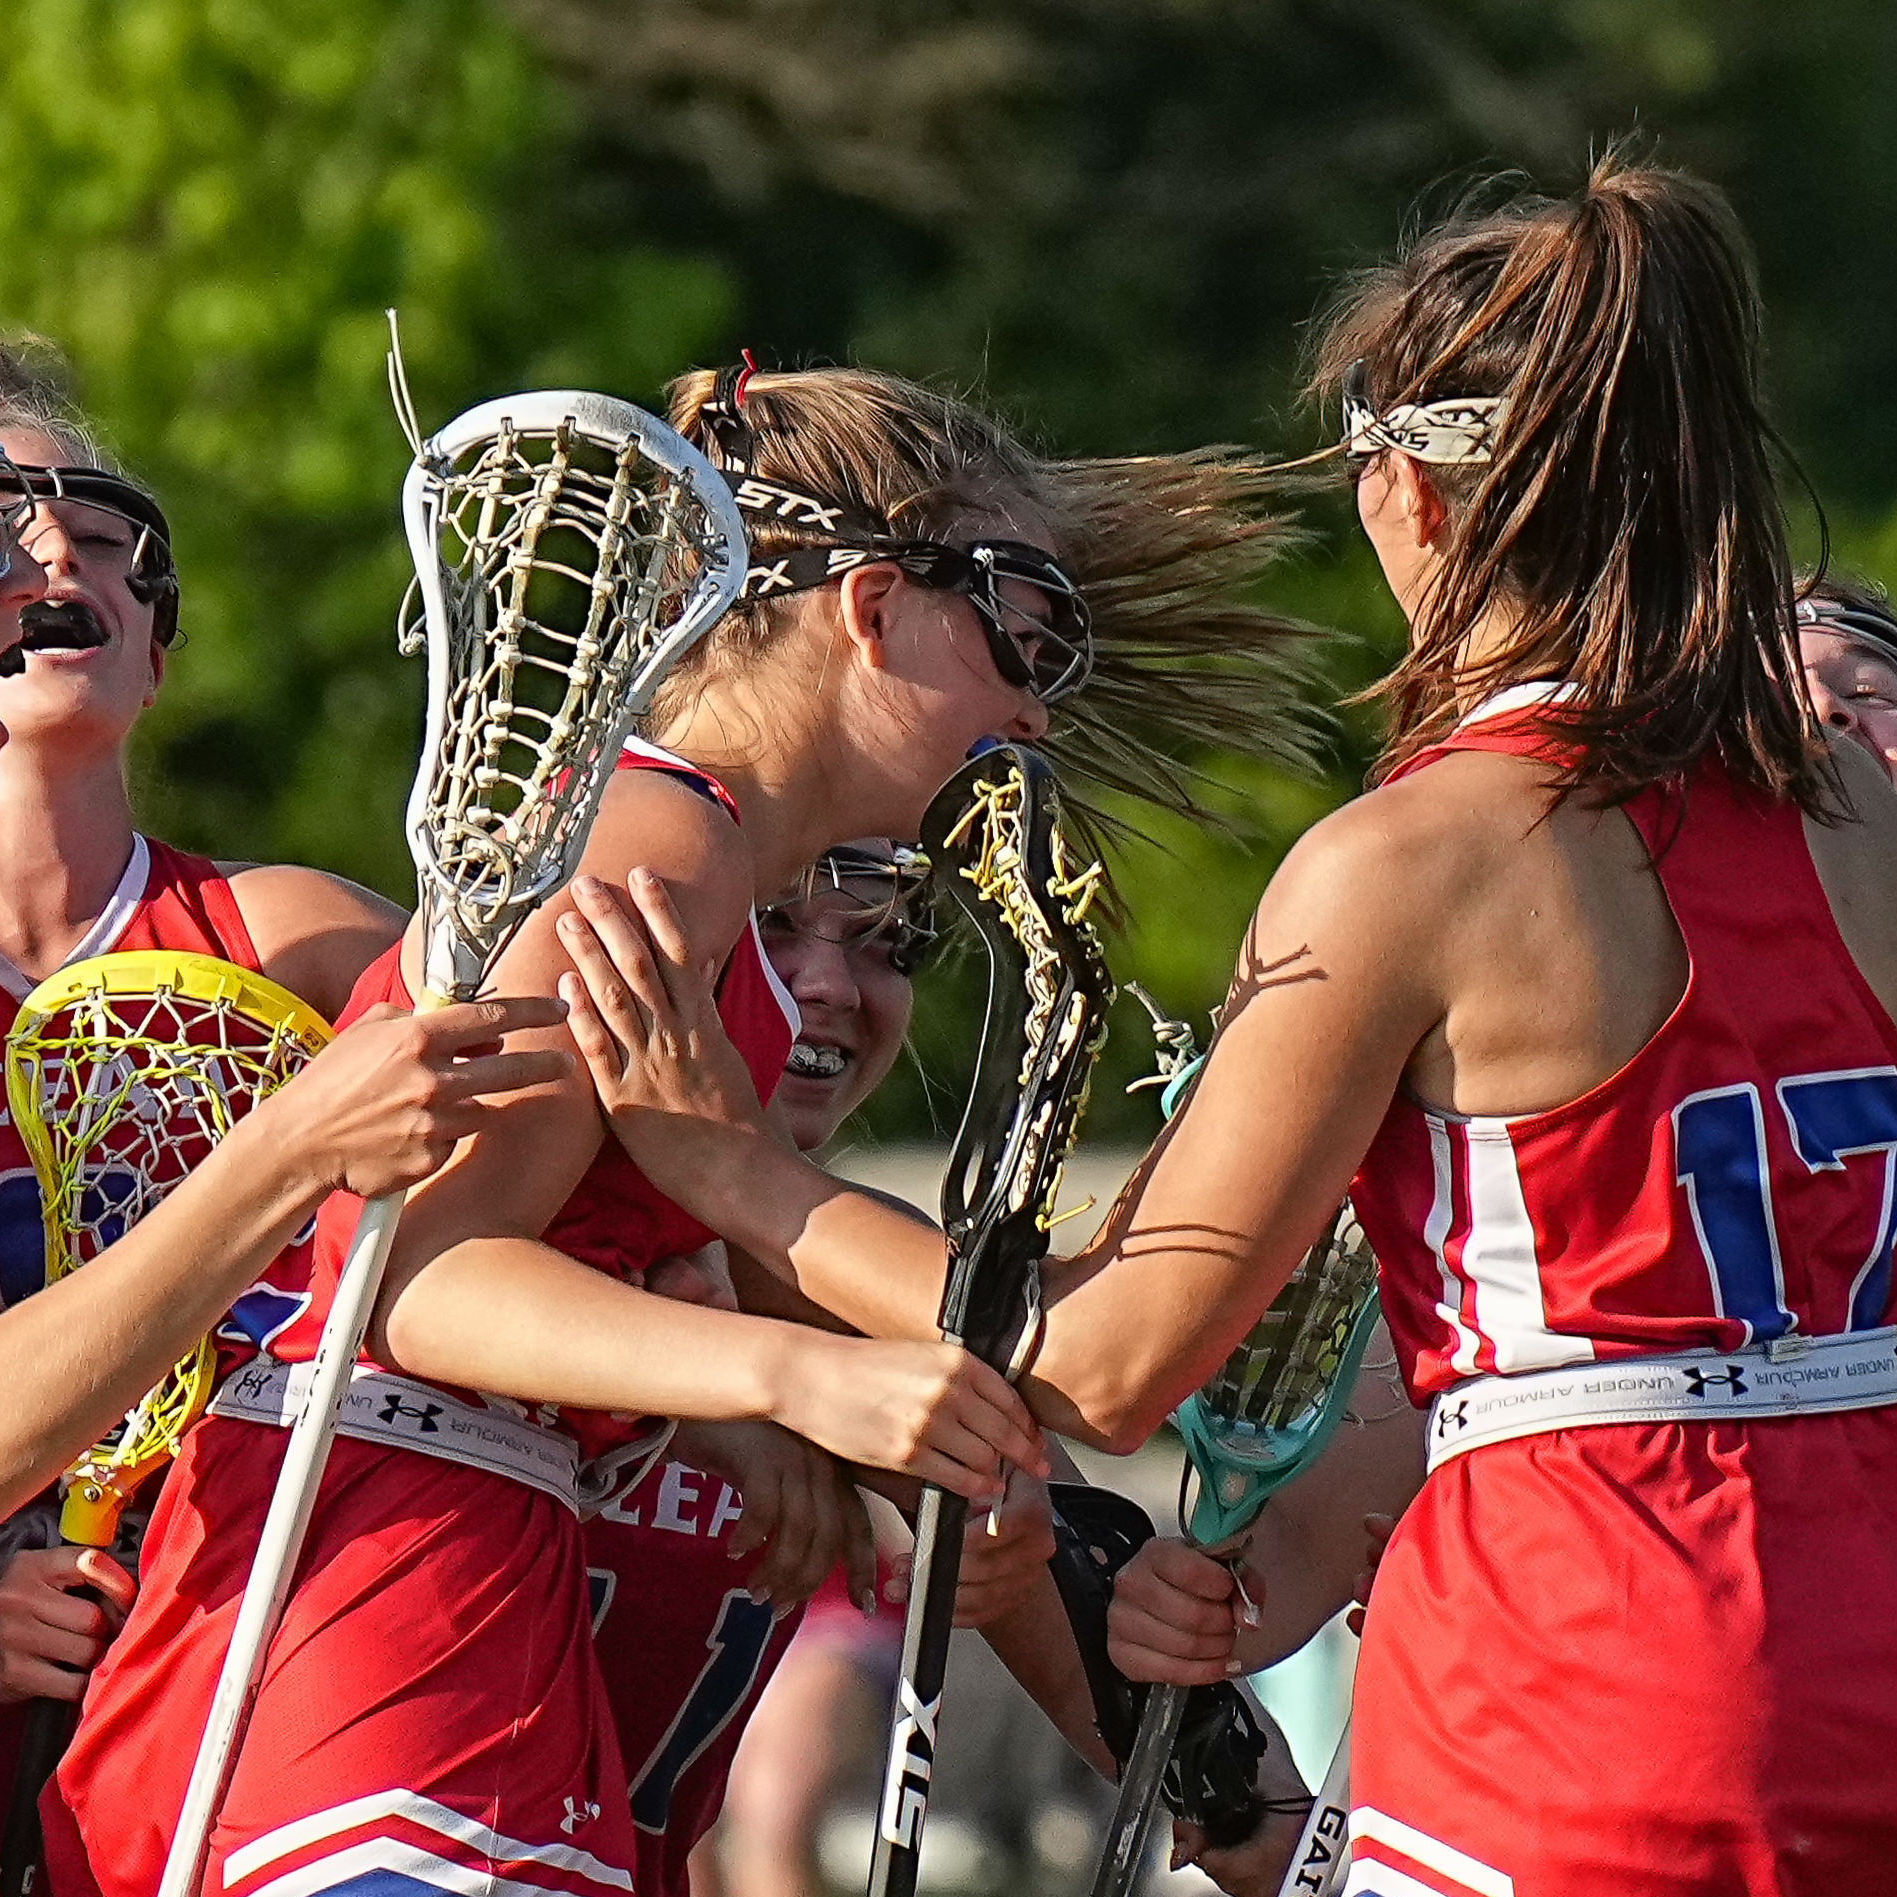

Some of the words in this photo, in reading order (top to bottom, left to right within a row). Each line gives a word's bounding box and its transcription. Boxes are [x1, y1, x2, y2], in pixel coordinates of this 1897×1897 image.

[734, 479, 844, 532] STX
[1583, 1376, 1675, 1394] UNDER
[880, 1676, 943, 1853] STX
